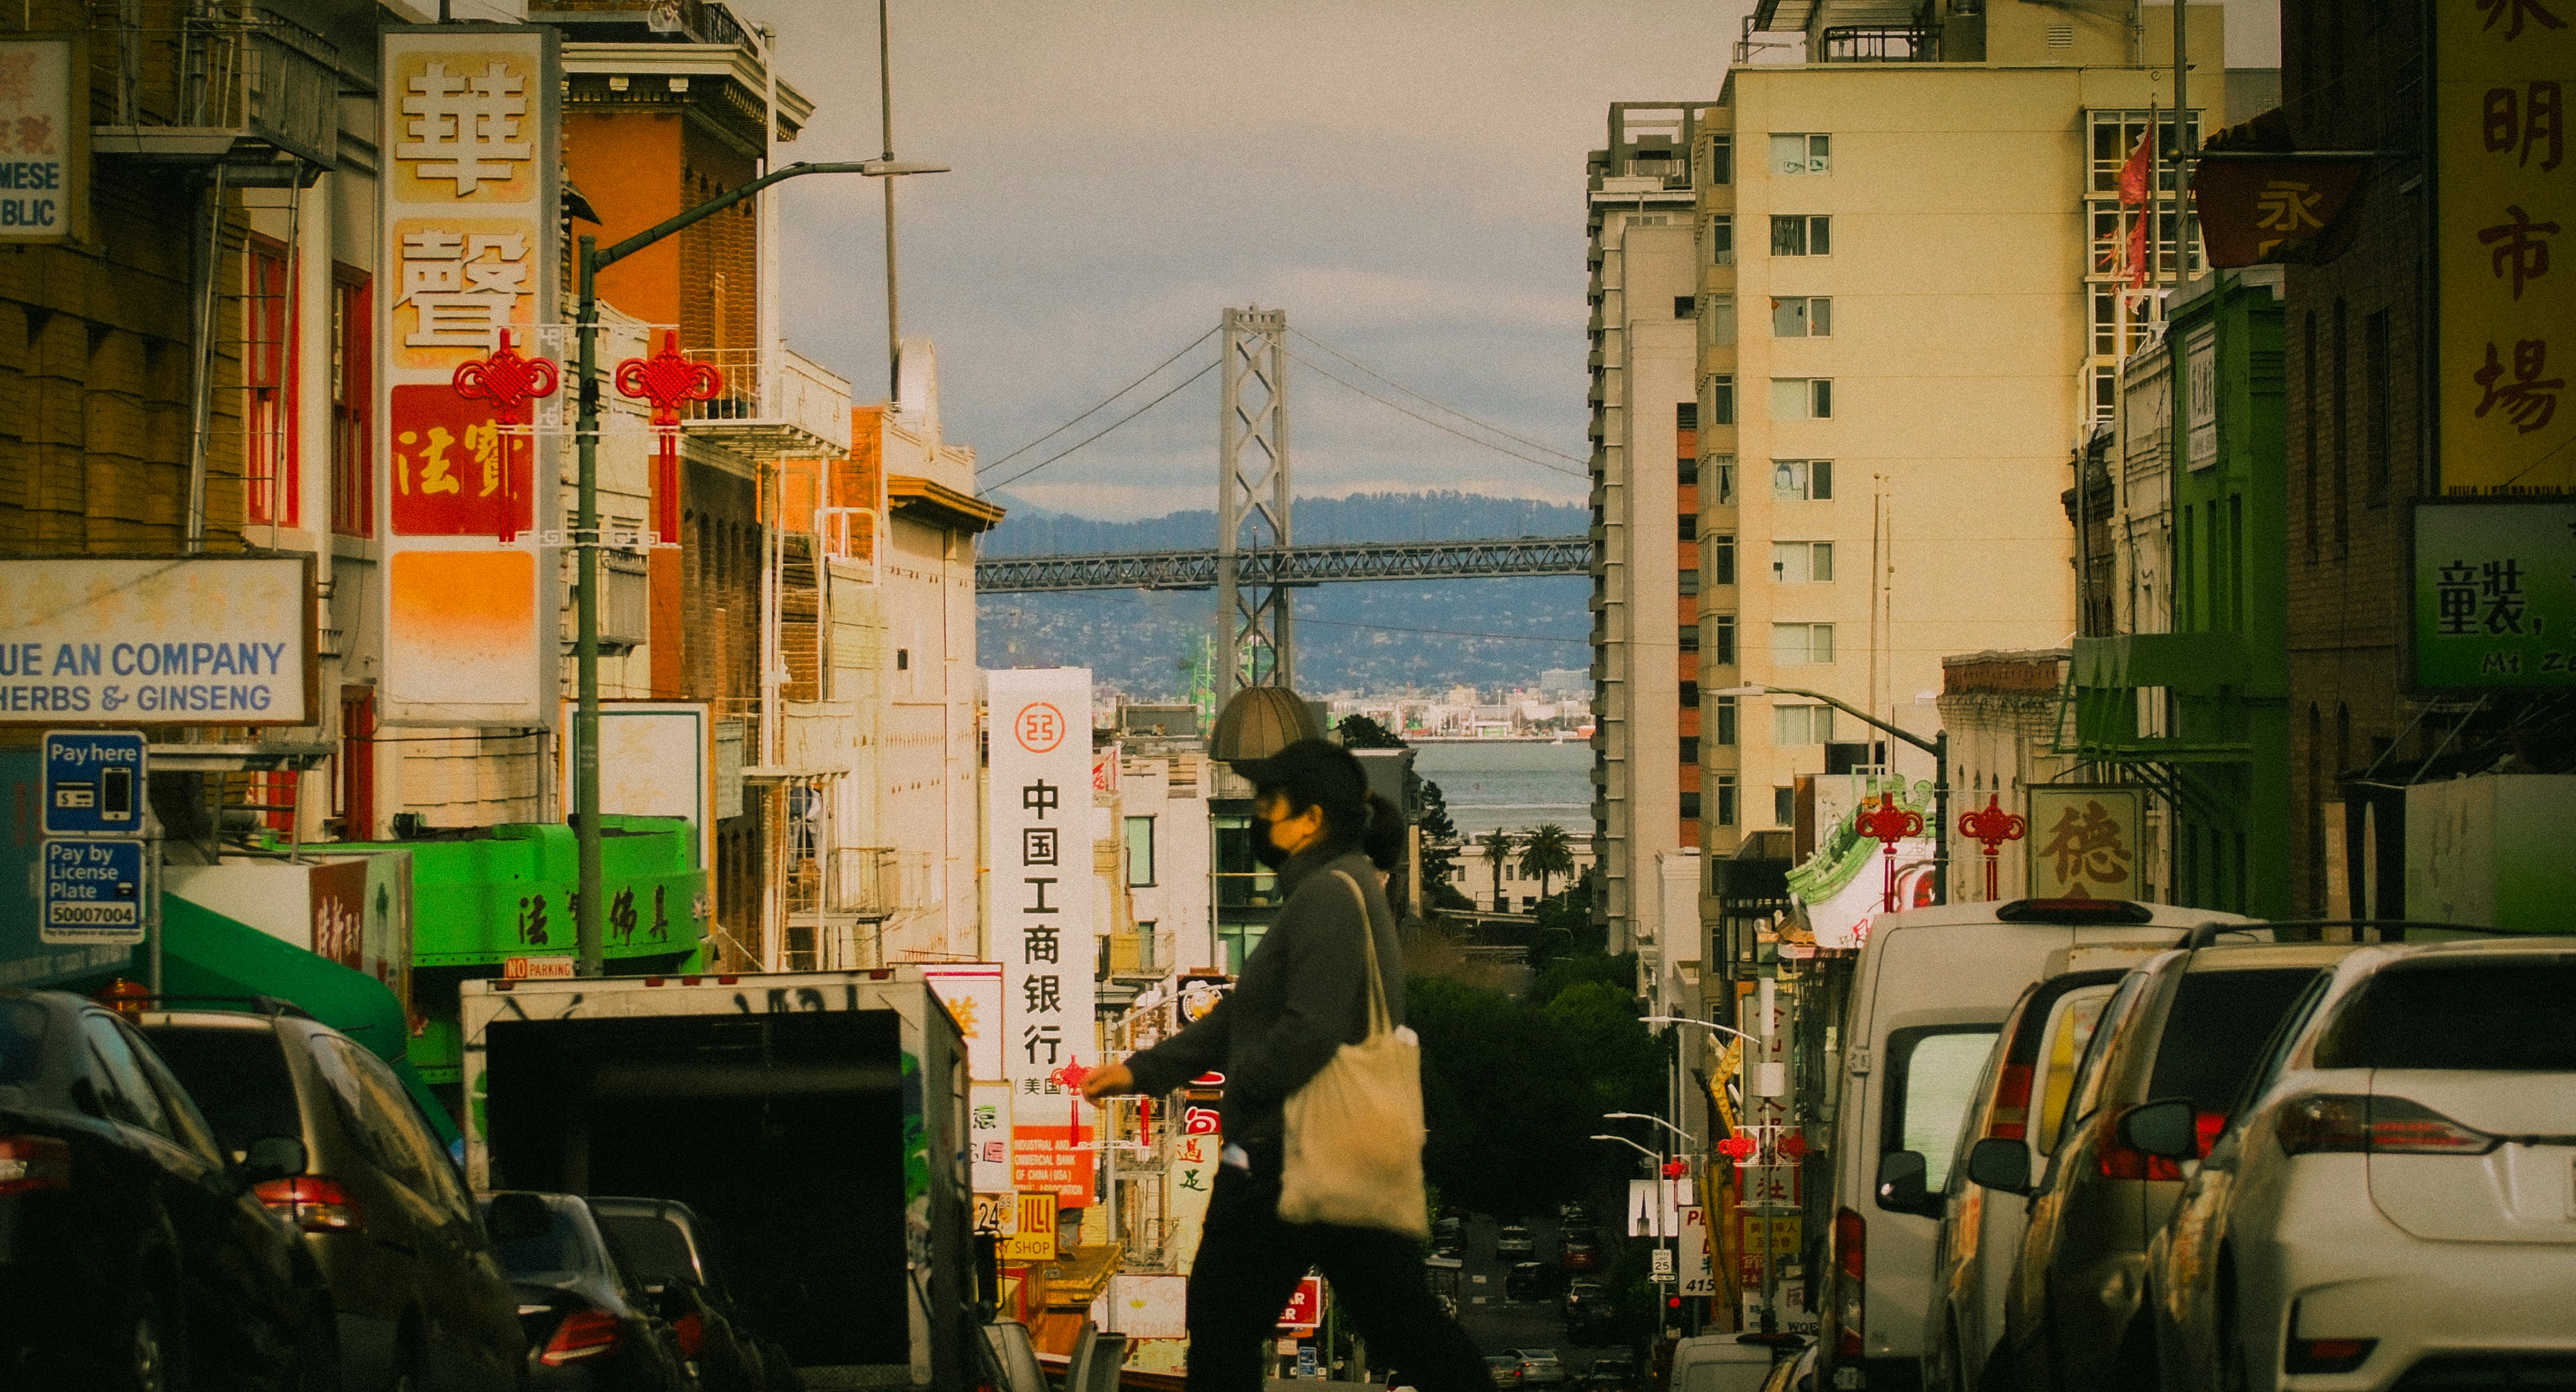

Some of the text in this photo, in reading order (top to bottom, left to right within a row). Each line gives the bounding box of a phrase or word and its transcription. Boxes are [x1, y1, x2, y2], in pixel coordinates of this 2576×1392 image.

[52, 643, 102, 675] AN
[112, 642, 286, 676] COMPANY
[102, 686, 129, 712] &
[137, 685, 271, 711] GINSENG
[52, 743, 137, 765] Pay here
[50, 845, 113, 865] Pay by
[2037, 800, 2132, 899] 德
[50, 863, 119, 880] License
[50, 882, 97, 898] Plate
[54, 907, 132, 923] 50007004
[1022, 777, 1062, 1065] 中国工商银行
[507, 958, 571, 977] NO PARKING
[1014, 1139, 1070, 1151] INDUSTRIAL AND
[1014, 1154, 1076, 1165] OMMERCIAL BANK
[1016, 1169, 1025, 1181] OF
[1016, 1241, 1050, 1254] SHOP
[1655, 1261, 1669, 1270] 25
